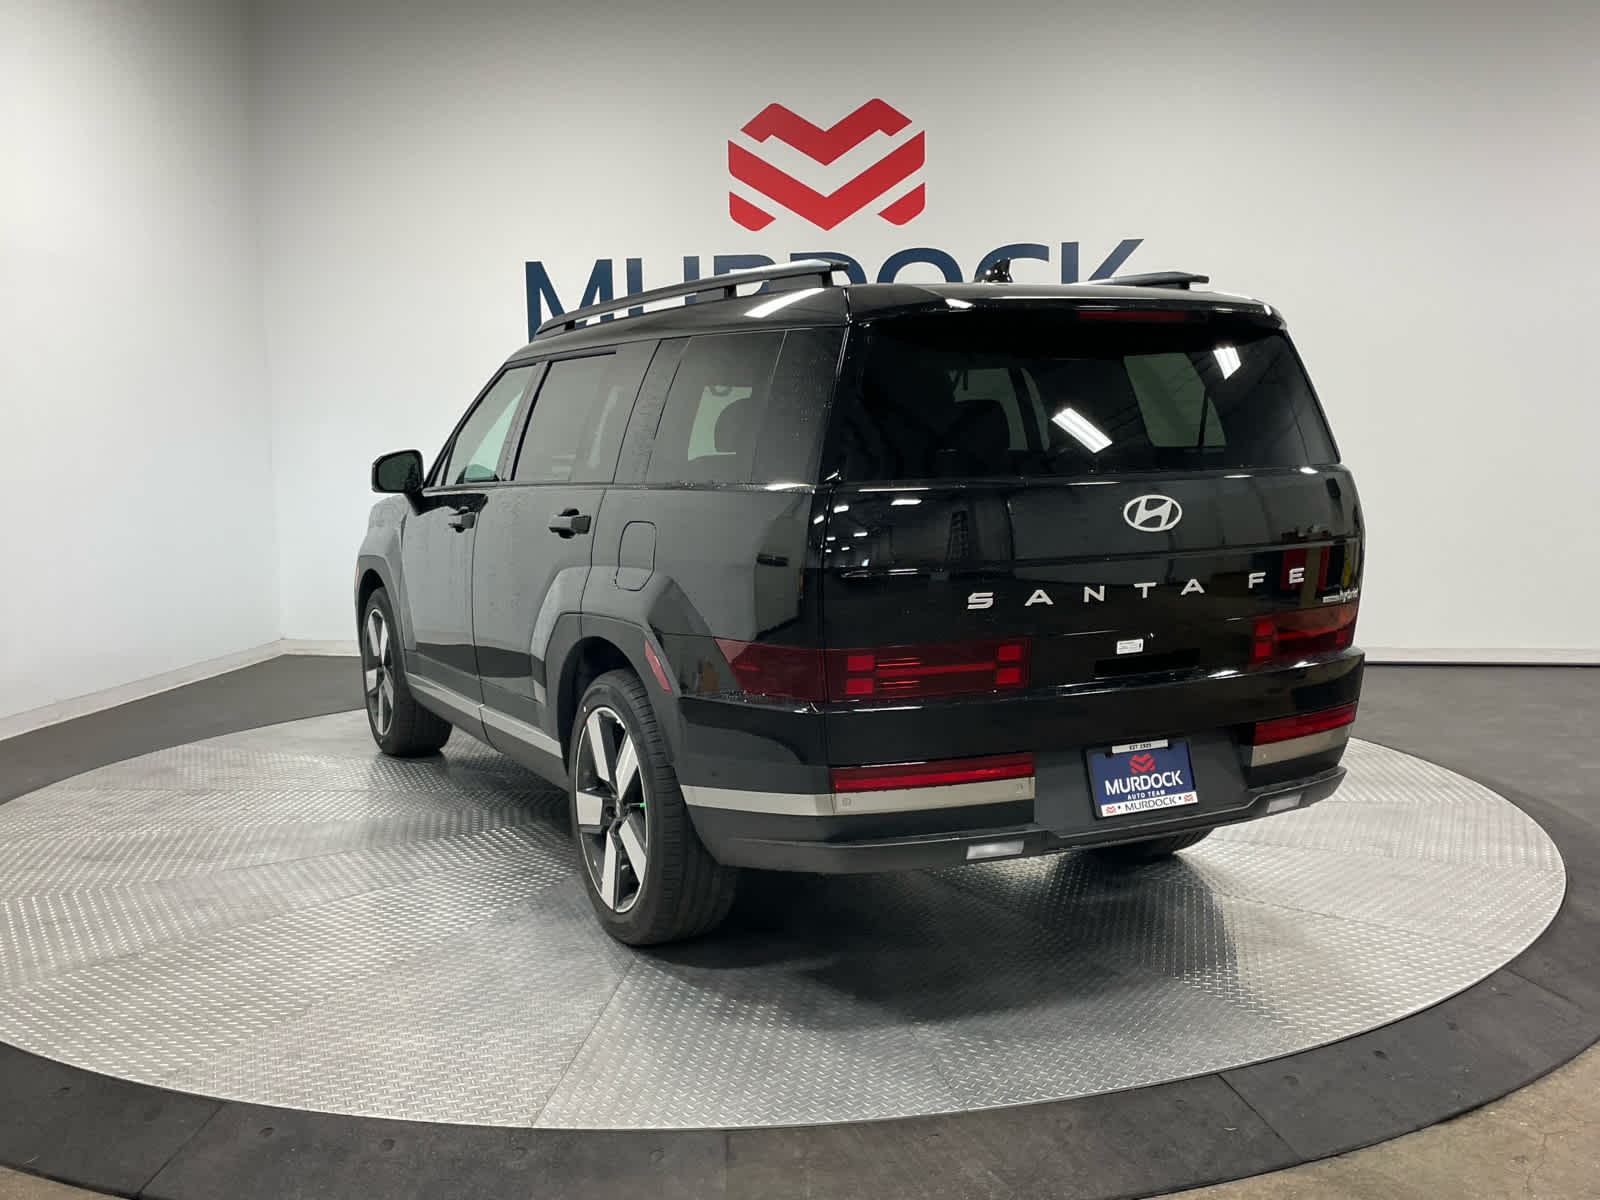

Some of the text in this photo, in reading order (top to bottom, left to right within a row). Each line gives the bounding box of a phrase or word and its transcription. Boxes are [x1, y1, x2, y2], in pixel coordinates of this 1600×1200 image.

[967, 567, 1306, 610] SANTA FE
[1104, 770, 1183, 796] MURDOCK
[1125, 796, 1177, 812] MURDOCK
[1127, 789, 1166, 801] AUTO TEAM
